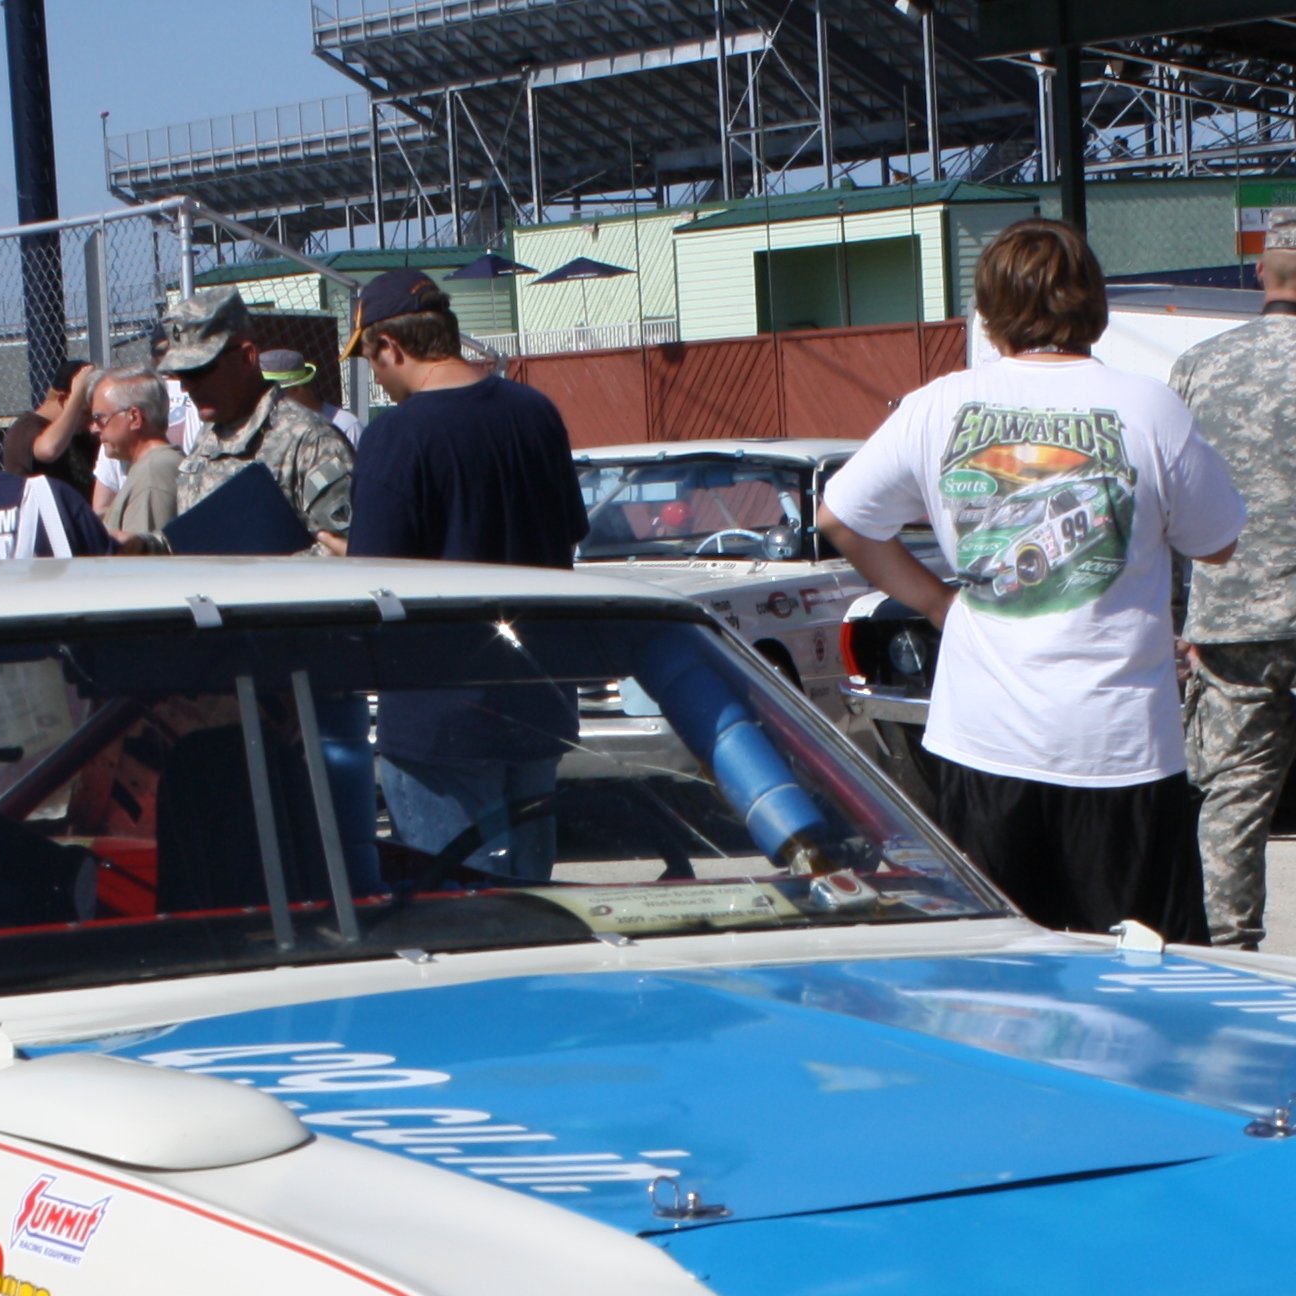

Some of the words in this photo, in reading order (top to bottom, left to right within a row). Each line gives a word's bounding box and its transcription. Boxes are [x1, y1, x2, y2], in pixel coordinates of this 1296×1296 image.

[940, 401, 1133, 475] EDWARDS
[944, 478, 988, 493] Scotts
[1061, 509, 1089, 549] 99
[18, 1239, 43, 1256] RACING
[43, 1245, 82, 1266] EQUIPMENT
